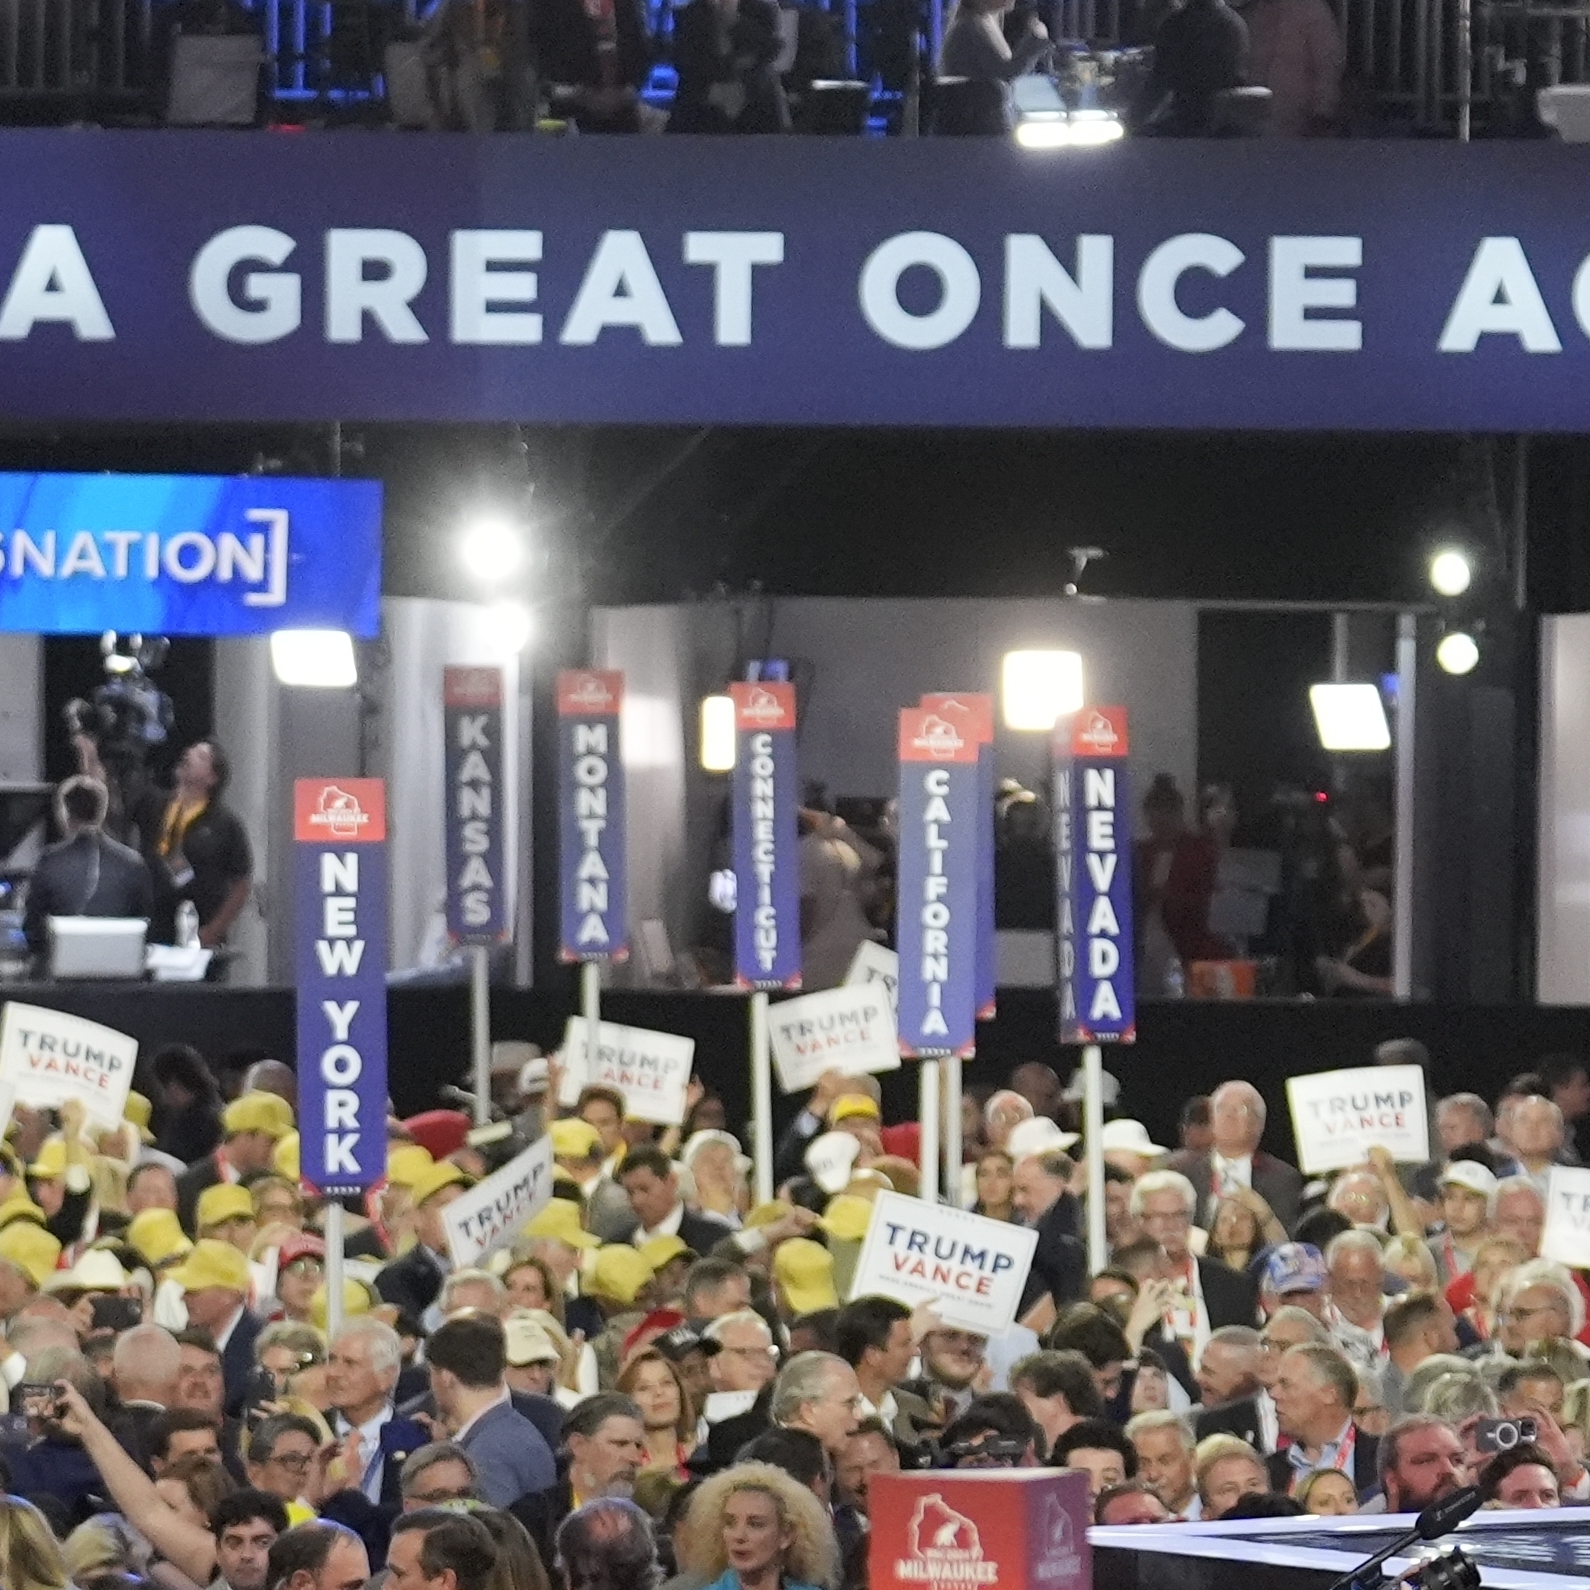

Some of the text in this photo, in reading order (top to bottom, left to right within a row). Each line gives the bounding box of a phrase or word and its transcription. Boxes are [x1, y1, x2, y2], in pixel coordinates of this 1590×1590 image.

[189, 223, 785, 348] GREAT
[857, 231, 1362, 352] ONCE
[456, 713, 495, 927] KANSAS
[573, 722, 610, 945] MONTANA
[750, 731, 776, 972] CONNECTICUT
[922, 768, 952, 1037] CALIFORNIA
[1084, 768, 1123, 1021] NEVADA
[316, 851, 366, 1175] NEW YORK
[779, 1004, 880, 1040] TRUMP
[18, 1028, 123, 1073] TRUMP
[580, 1039, 681, 1076] TRUMP
[794, 1026, 870, 1058] VANCE
[28, 1053, 109, 1088] VANCE
[601, 1066, 667, 1091] ANCE
[1308, 1089, 1413, 1120] TRUMP
[1322, 1111, 1406, 1132] VANCE
[458, 1162, 545, 1238] TRUMP
[886, 1221, 1015, 1274] TRUMP
[893, 1251, 994, 1296] VANCE
[894, 1557, 999, 1584] MILWAUKEE
